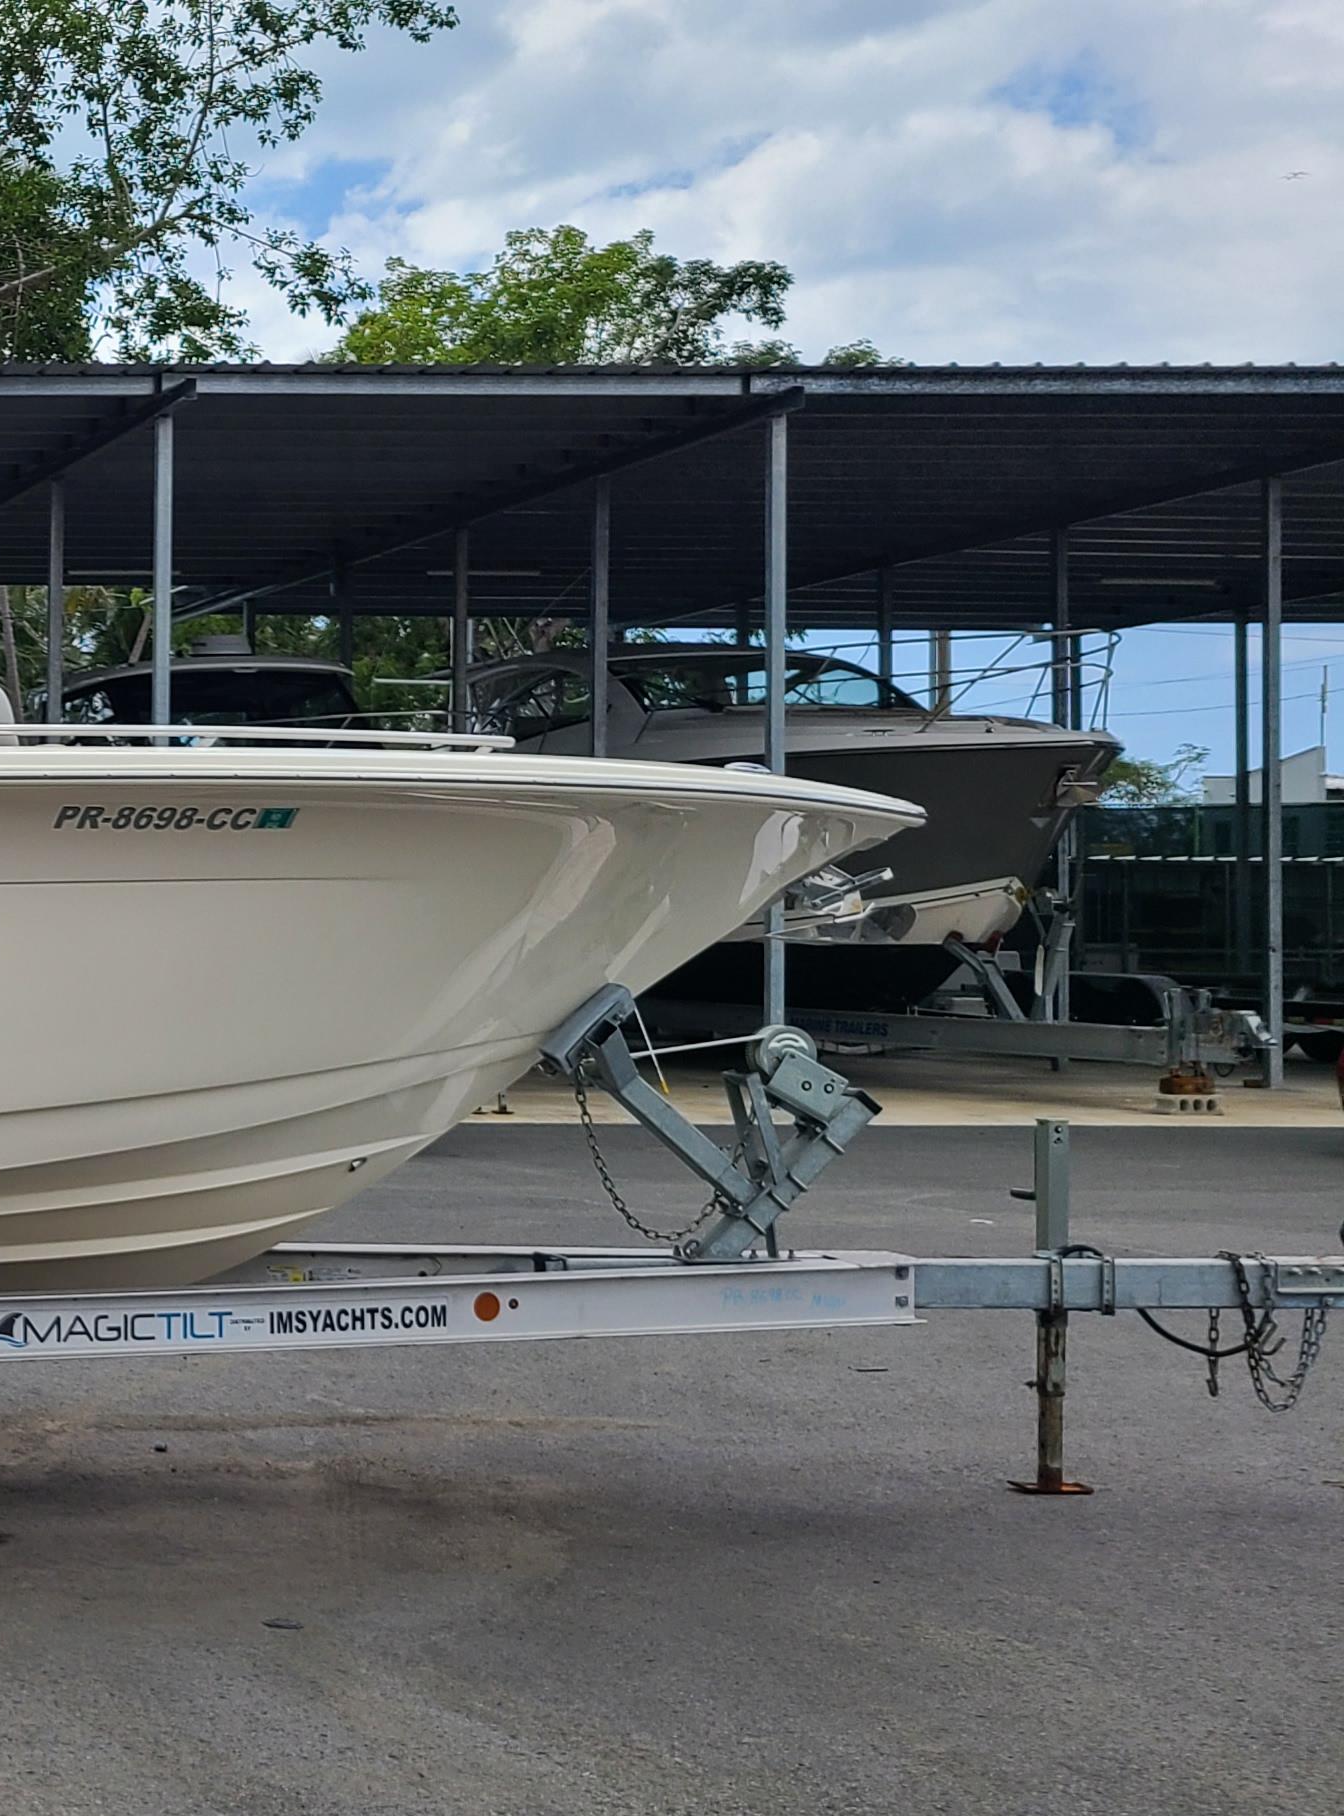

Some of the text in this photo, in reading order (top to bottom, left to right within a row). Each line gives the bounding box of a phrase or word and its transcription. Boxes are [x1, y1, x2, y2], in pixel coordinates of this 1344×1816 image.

[53, 805, 258, 831] PR-8698-CC
[834, 1018, 889, 1037] TRAILERS
[22, 1311, 233, 1343] MAGICTILT
[269, 1304, 448, 1335] IMSYACHTS.COM
